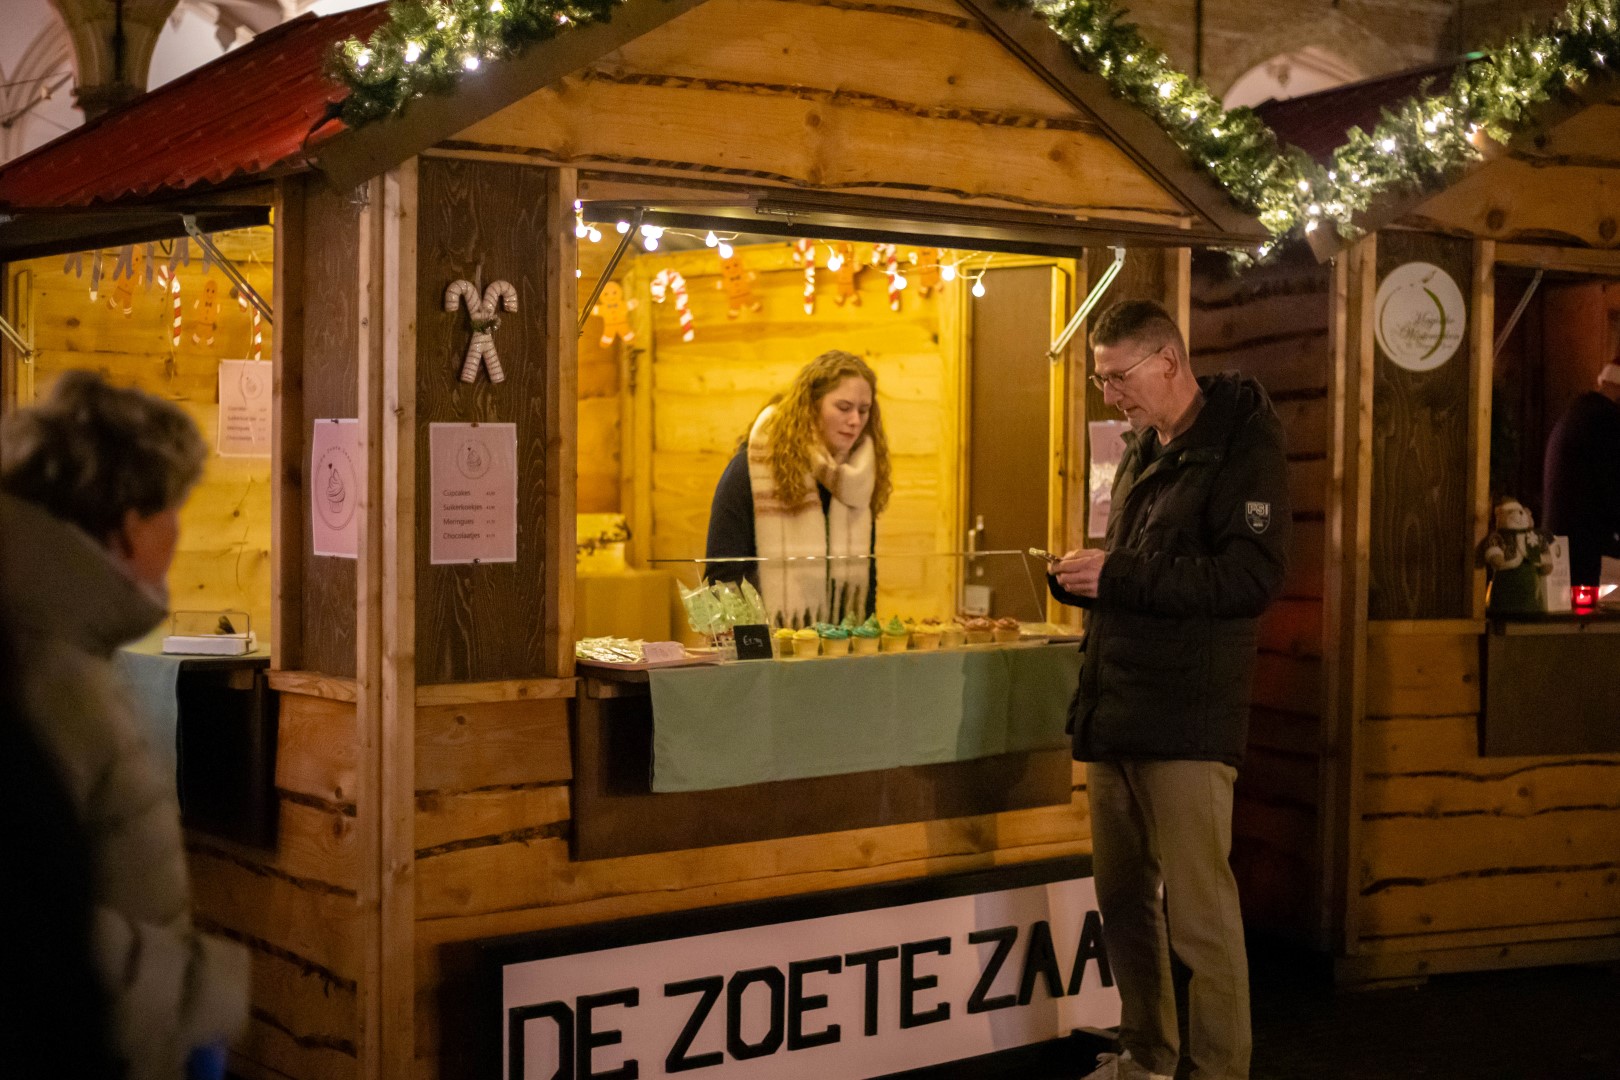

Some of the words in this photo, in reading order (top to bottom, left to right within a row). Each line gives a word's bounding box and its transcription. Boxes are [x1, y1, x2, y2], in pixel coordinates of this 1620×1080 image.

[443, 489, 471, 497] Cupcakes
[443, 504, 483, 512] Suikerkoekjes
[443, 518, 474, 526] Meringues
[442, 532, 481, 540] Chocolaatjes
[508, 987, 640, 1080] DE
[664, 936, 952, 1074] ZOETE
[967, 910, 1114, 1014] ZAA
